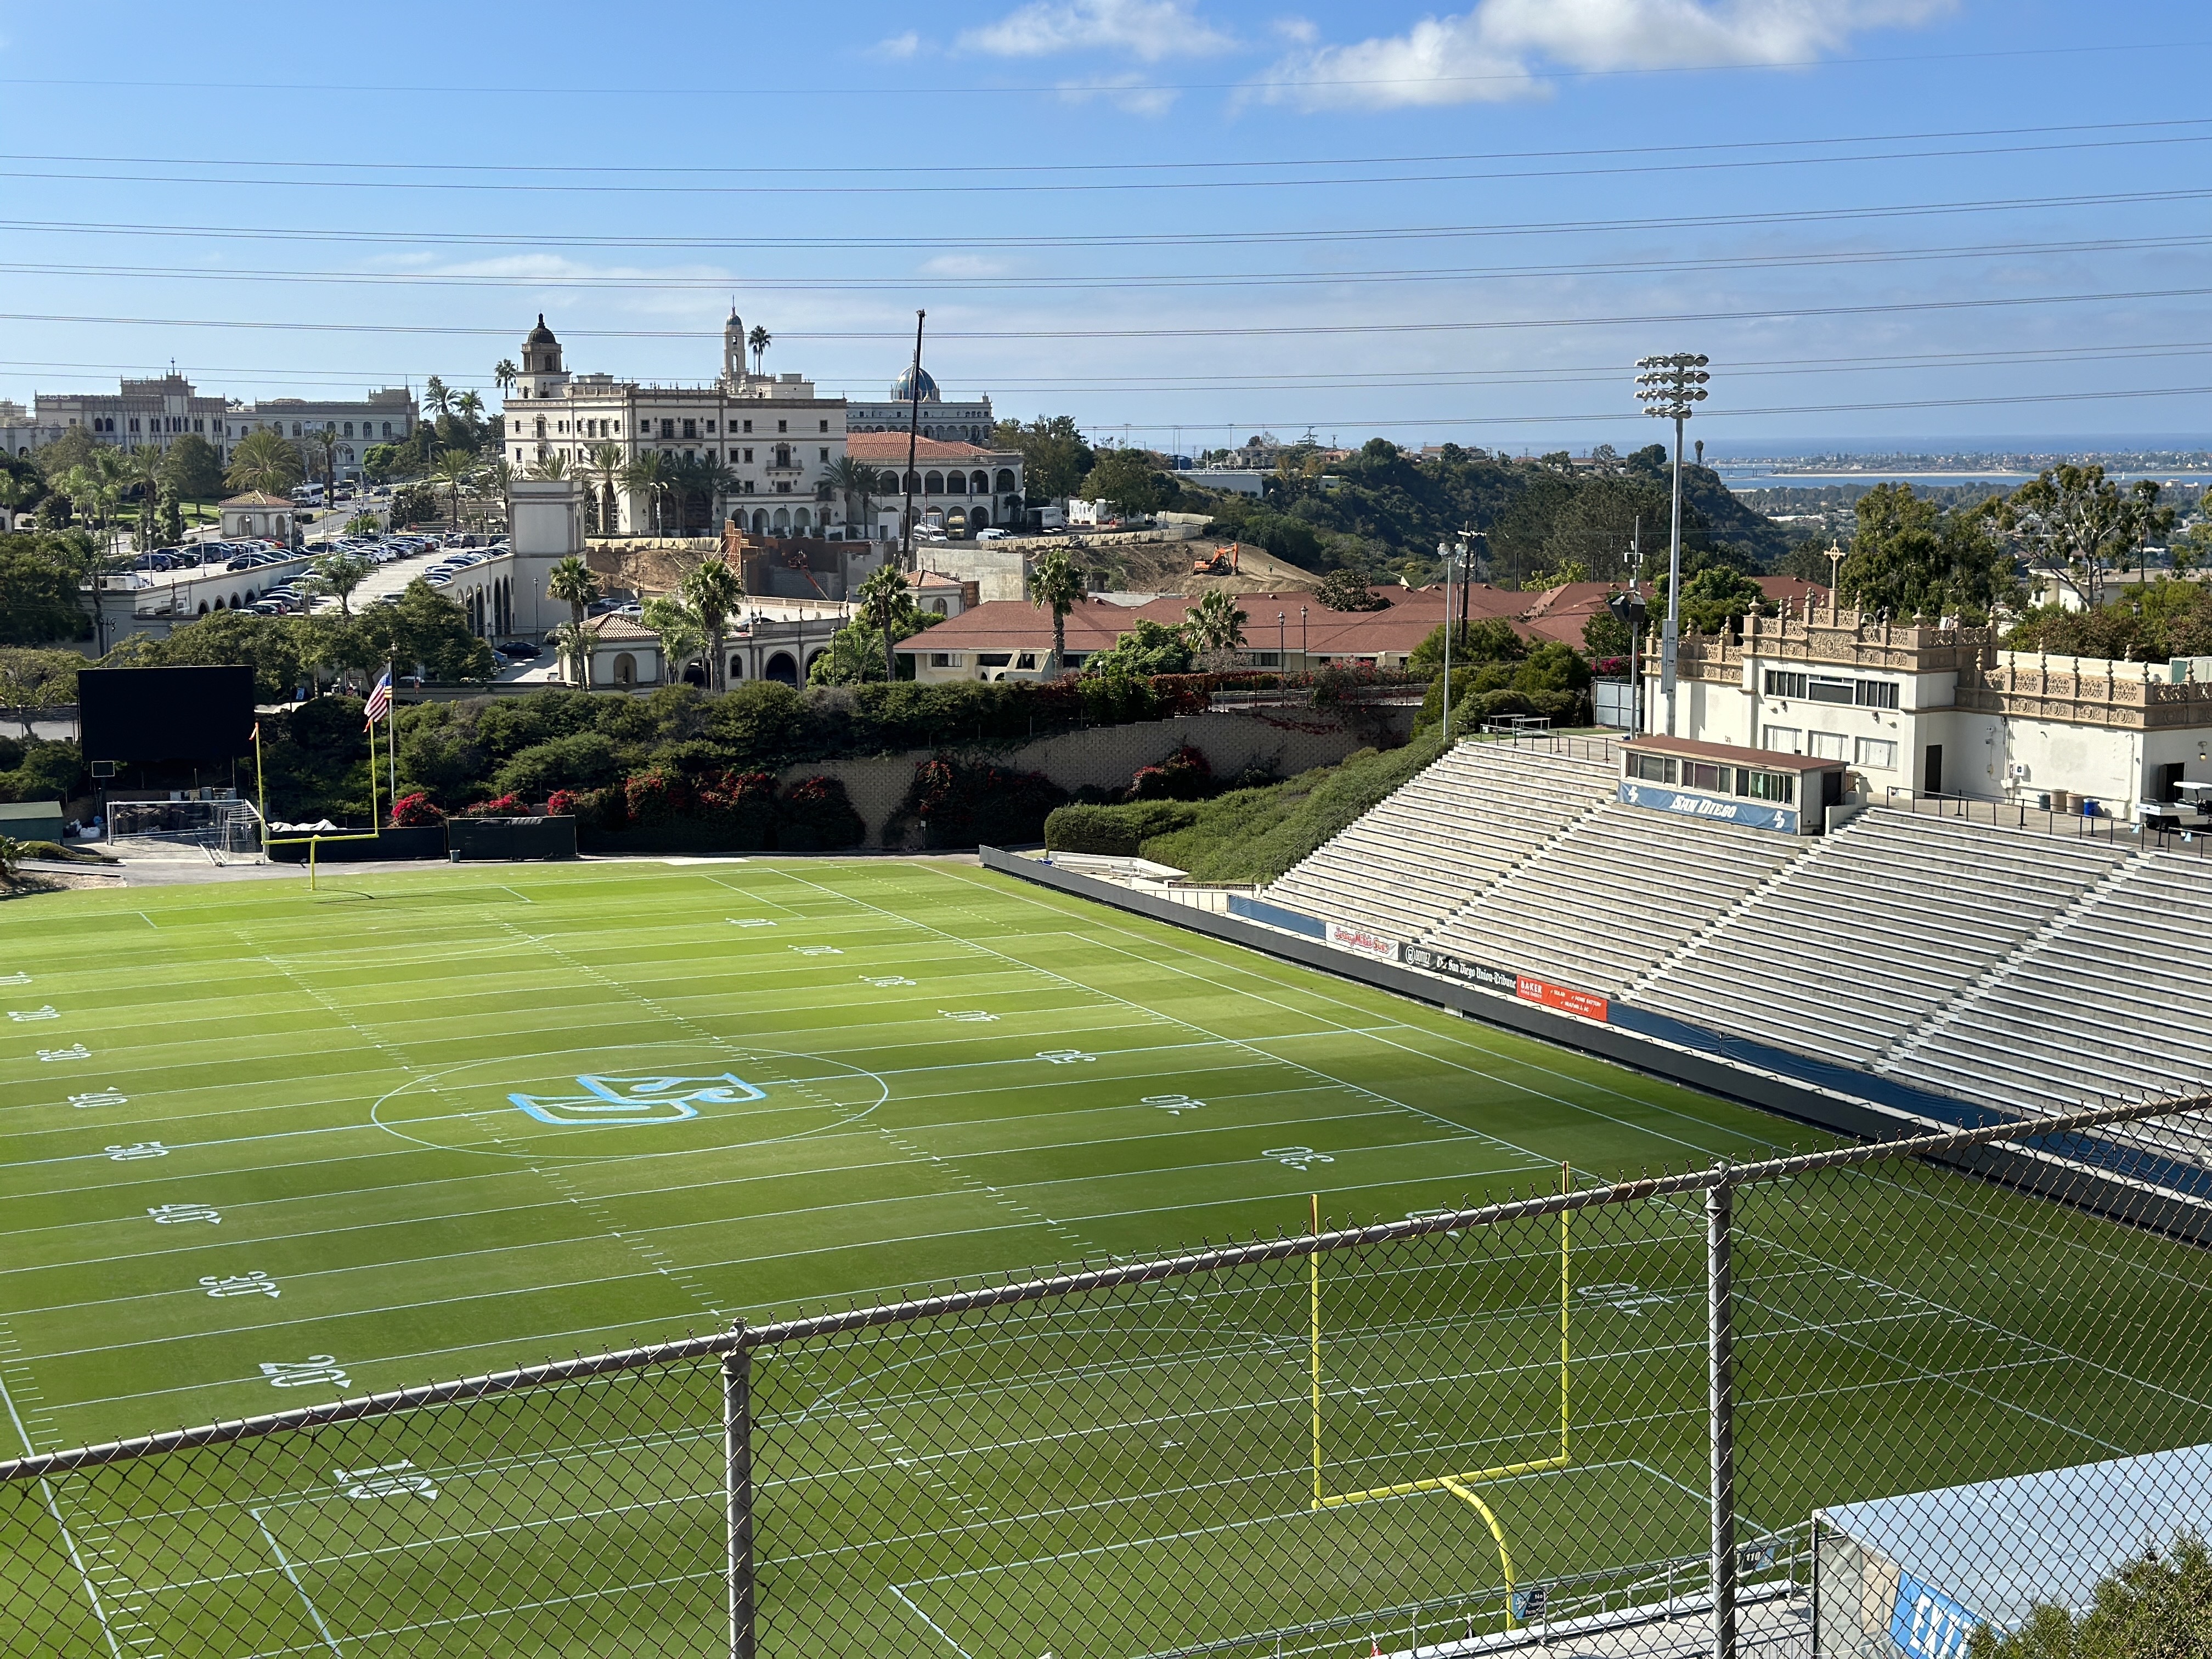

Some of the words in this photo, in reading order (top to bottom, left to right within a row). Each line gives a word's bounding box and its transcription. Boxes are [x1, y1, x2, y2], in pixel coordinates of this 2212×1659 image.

[1415, 950, 1431, 965] GOMEZ
[1436, 955, 1447, 969] Te
[1448, 959, 1459, 973] San
[1460, 963, 1476, 979] Diego
[1520, 980, 1542, 994] BAKER
[258, 1355, 346, 1387] 20
[1746, 1551, 1760, 1562] 110
